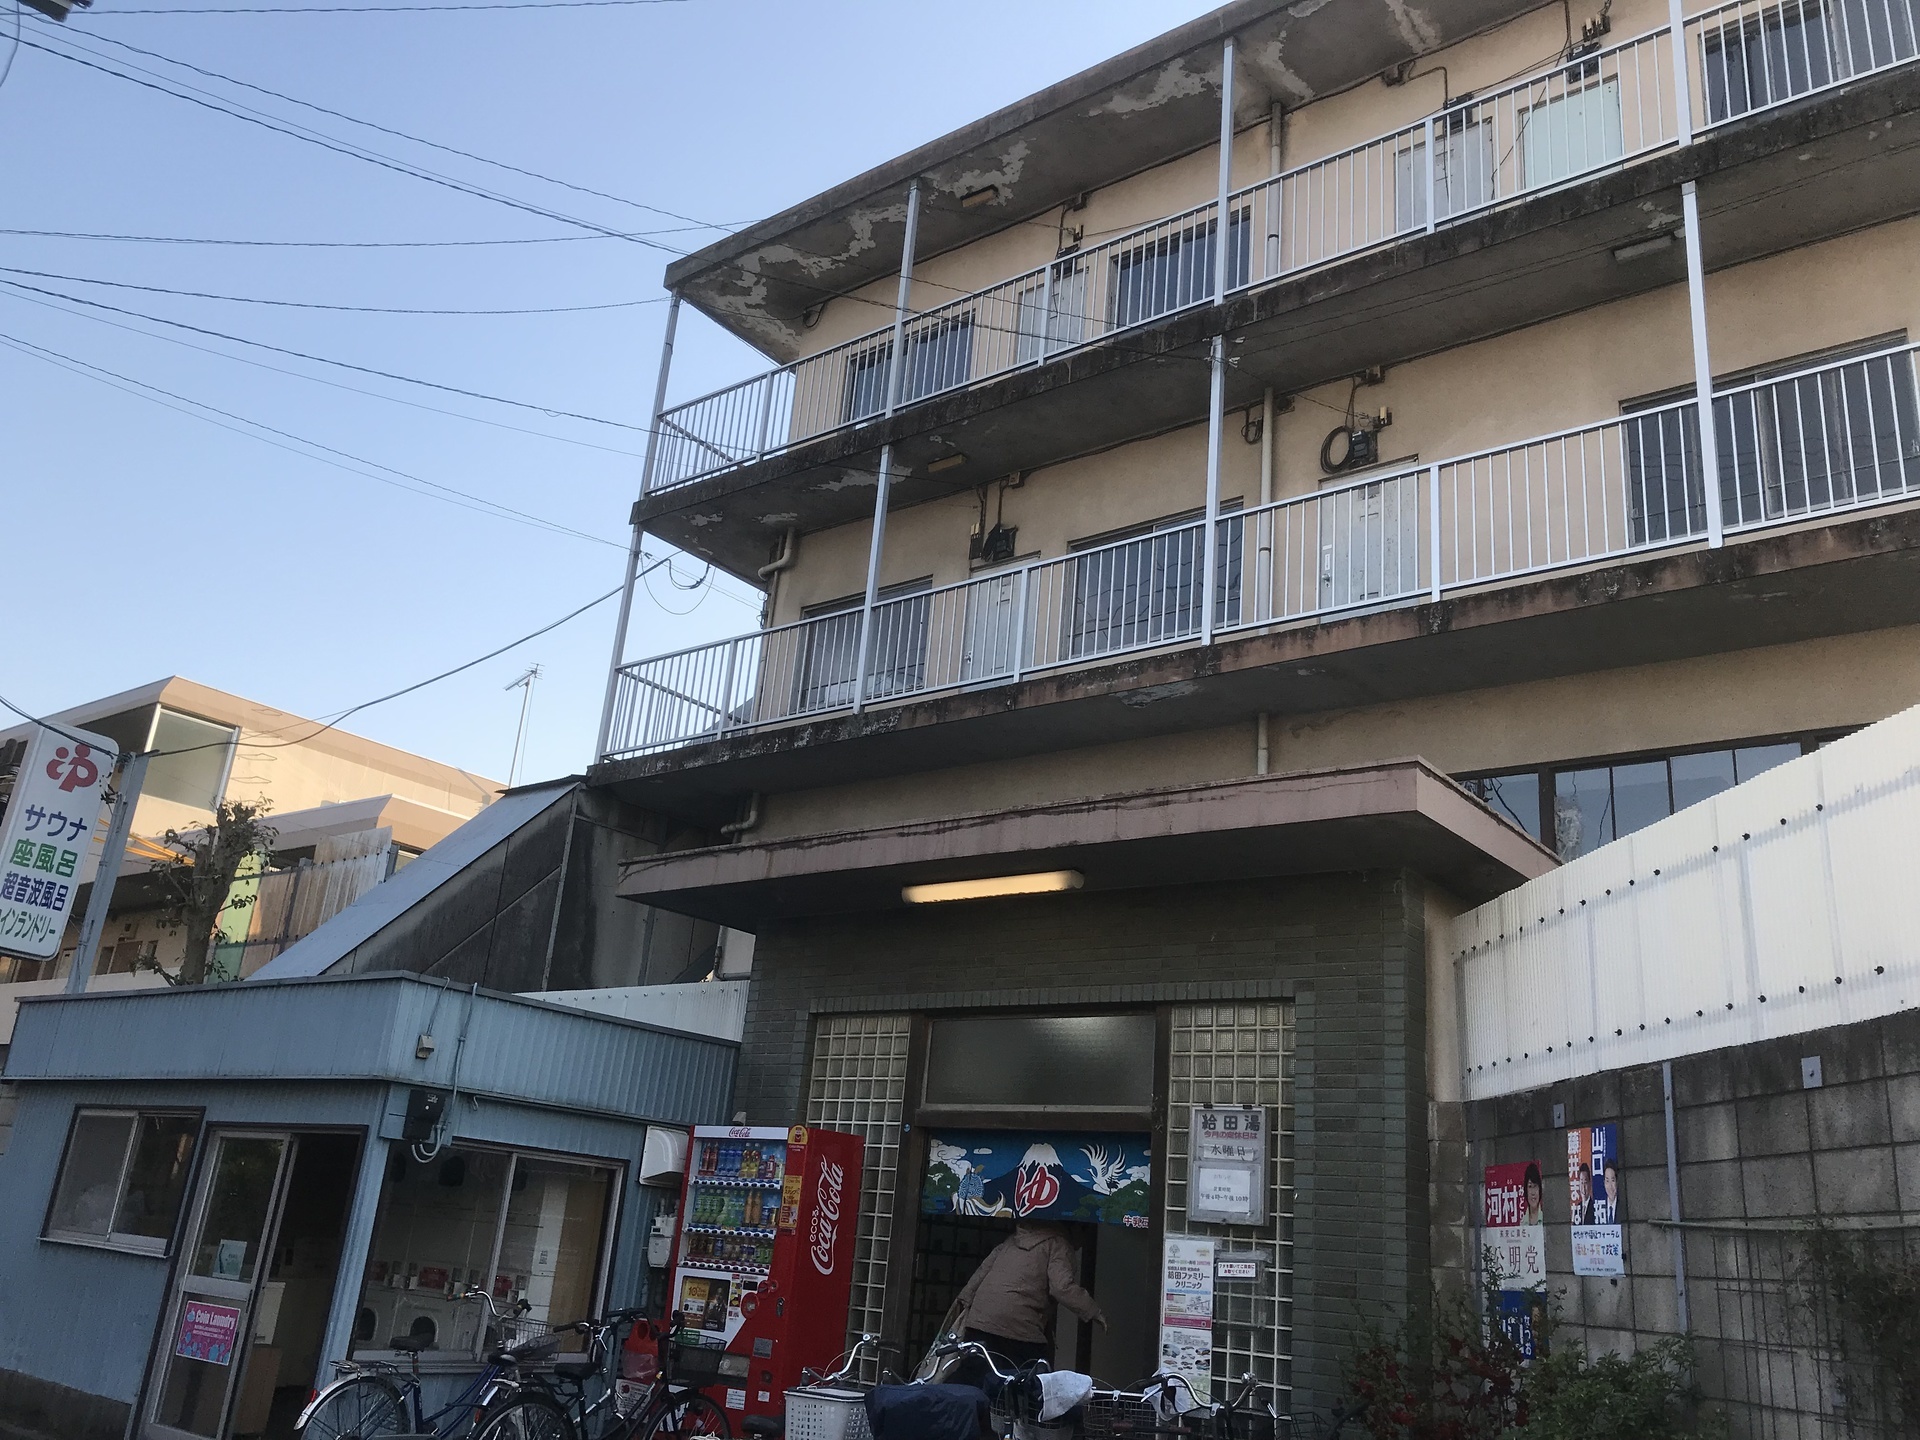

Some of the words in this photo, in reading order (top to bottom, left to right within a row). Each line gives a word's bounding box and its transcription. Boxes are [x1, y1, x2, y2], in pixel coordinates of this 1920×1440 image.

[25, 804, 87, 841] サウナ
[9, 838, 78, 877] 座風呂
[0, 871, 69, 911] 超音波風呂
[0, 907, 56, 943] インランドリー
[1202, 1113, 1260, 1131] 給田湯
[1204, 1130, 1258, 1139] 今月の定休日は
[1211, 1144, 1246, 1157] 水曜日
[1014, 1166, 1060, 1217] ゆ
[1568, 1131, 1581, 1225] 藤井まな
[811, 1154, 844, 1275] Coca-Cola
[1487, 1185, 1518, 1224] 河村
[1168, 1271, 1210, 1281] 給田ファミリー
[1175, 1280, 1202, 1289] クリニック
